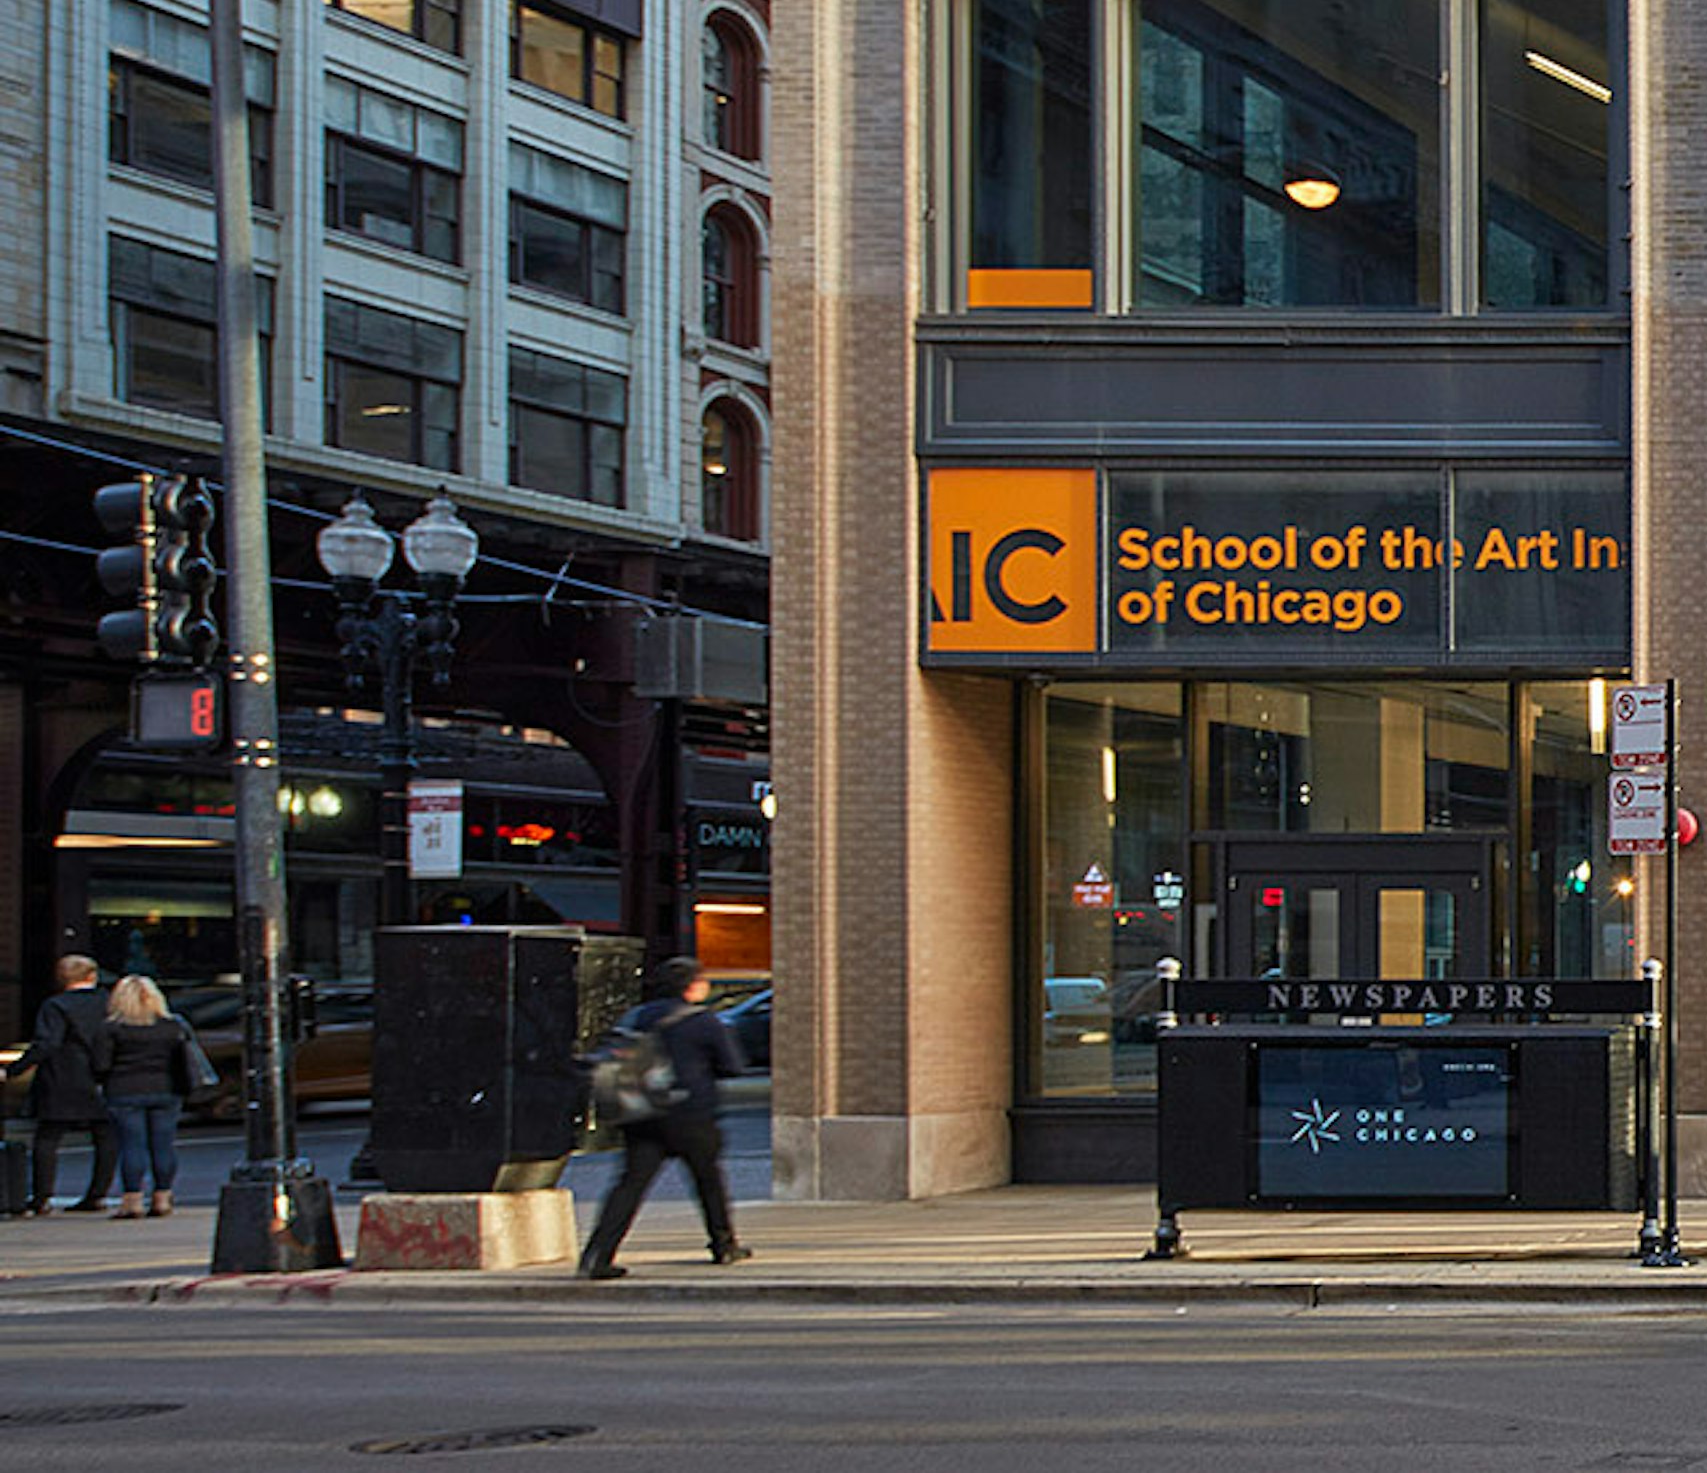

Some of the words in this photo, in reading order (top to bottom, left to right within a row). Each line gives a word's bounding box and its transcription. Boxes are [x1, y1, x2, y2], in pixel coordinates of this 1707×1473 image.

[1118, 527, 1297, 570] School
[1310, 526, 1366, 569] of
[1380, 526, 1464, 569] the
[1475, 527, 1558, 569] Art
[931, 528, 1067, 625] IC
[1118, 580, 1174, 624] of
[1185, 580, 1403, 631] Chicago
[1268, 983, 1553, 1009] NEWSPAPERS
[1356, 1109, 1404, 1123] ONE
[1356, 1128, 1476, 1142] CHICAGO
